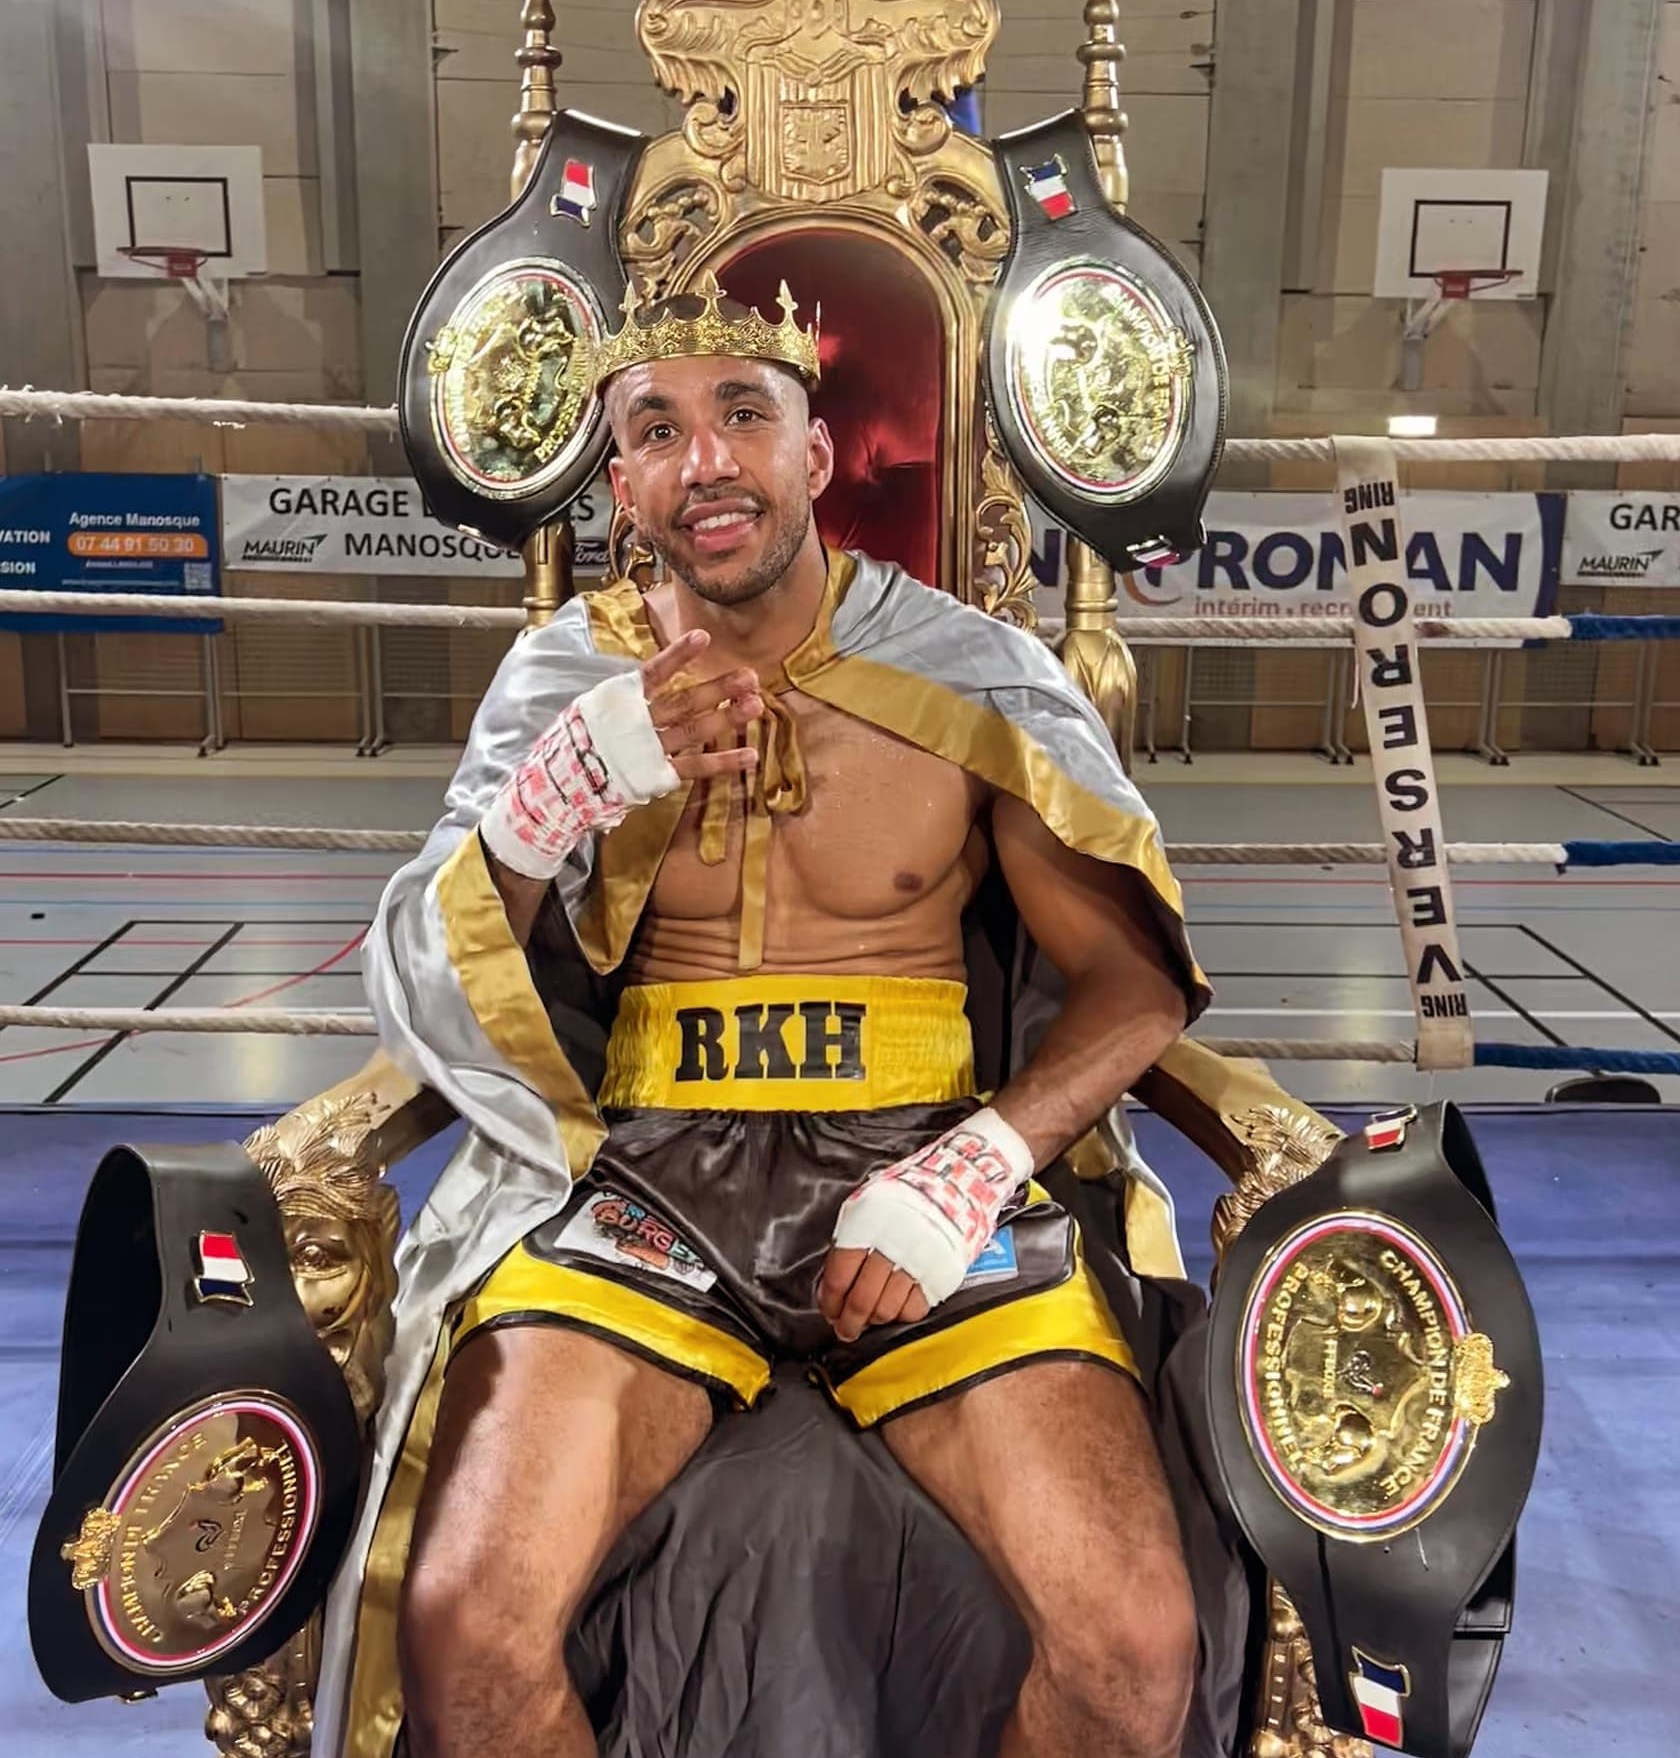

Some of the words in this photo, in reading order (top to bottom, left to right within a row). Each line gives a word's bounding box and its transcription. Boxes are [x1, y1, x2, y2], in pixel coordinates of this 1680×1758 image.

[269, 488, 409, 517] GARAGE
[1344, 481, 1395, 514] RING
[69, 512, 122, 528] Agence
[126, 512, 200, 530] Manosque
[76, 536, 98, 551] 07
[244, 540, 316, 556] MAURIN
[1580, 557, 1649, 571] MAURIN
[1421, 994, 1468, 1018] RING
[675, 1001, 867, 1082] RKH
[1380, 1250, 1450, 1367] CHAMPION
[1264, 1261, 1311, 1472] PROFESSIONNEL
[1428, 1373, 1448, 1406] DE
[1379, 1408, 1447, 1498] FRANCE
[236, 1438, 298, 1616] PROFESSIONNEL
